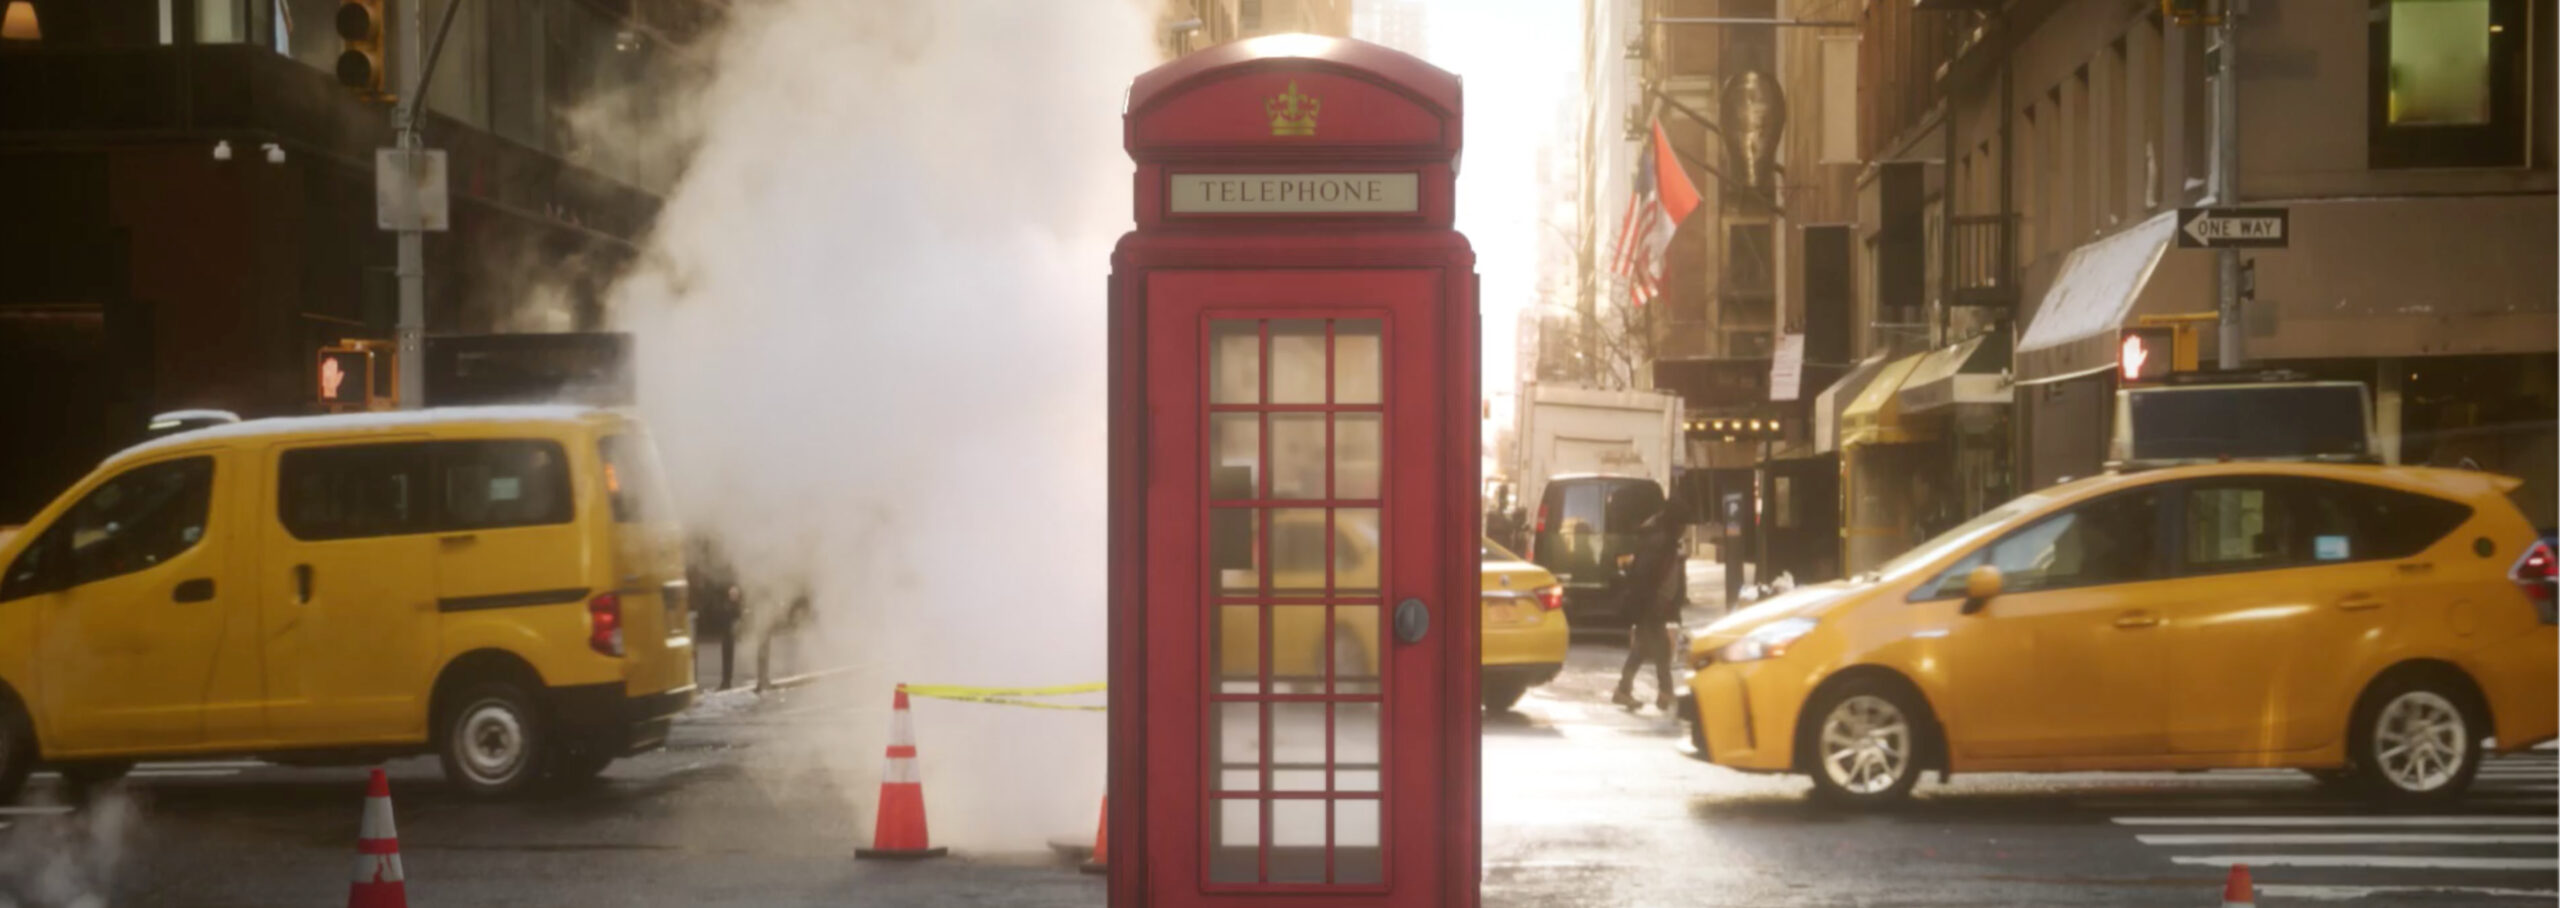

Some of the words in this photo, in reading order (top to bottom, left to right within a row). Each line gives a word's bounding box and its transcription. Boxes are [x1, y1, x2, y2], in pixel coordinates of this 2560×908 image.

[1199, 180, 1384, 202] TELEPHONE
[2198, 219, 2231, 237] ONE
[2240, 219, 2274, 237] WAY
